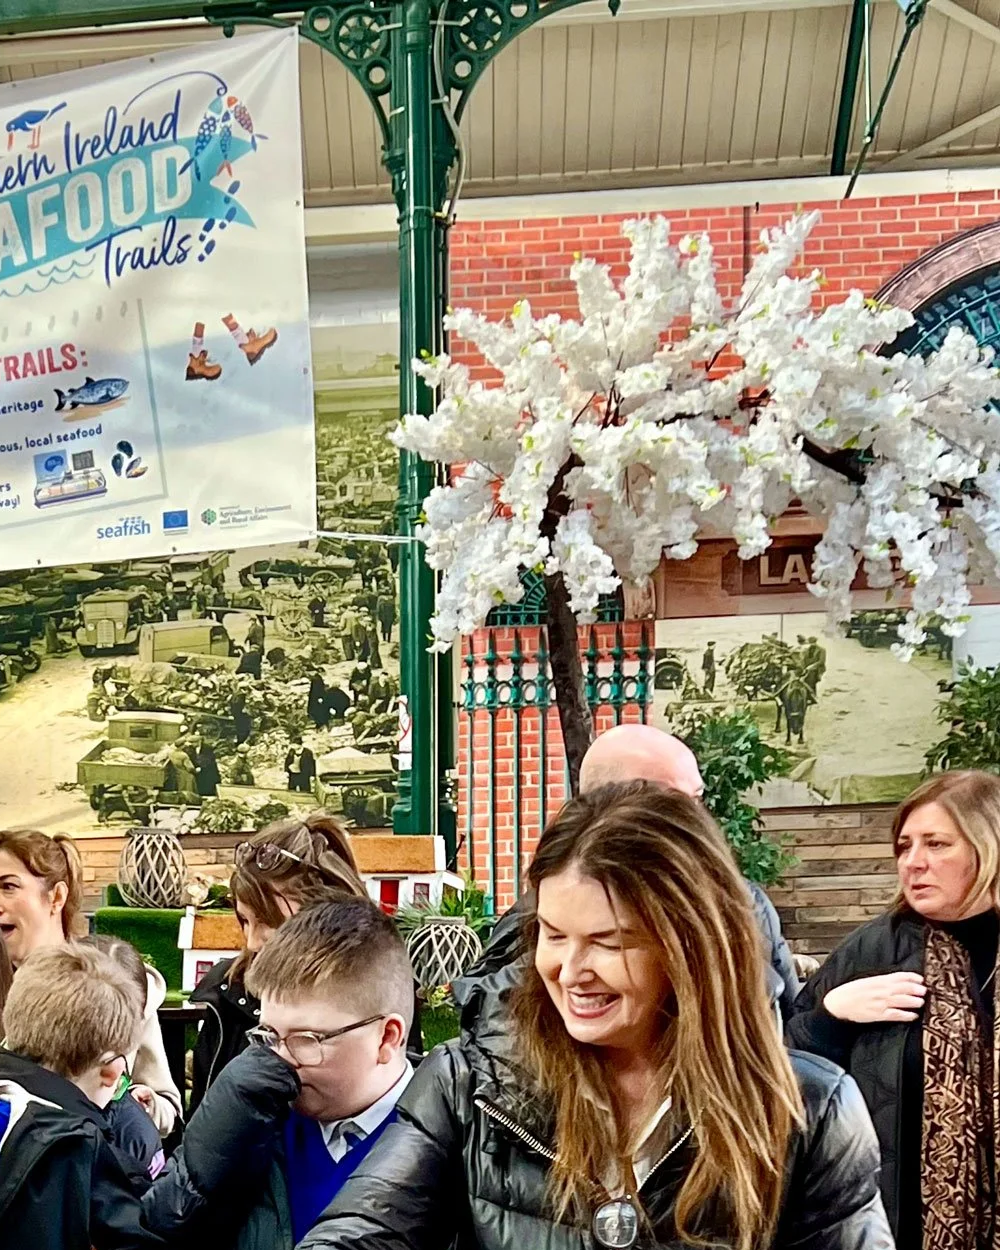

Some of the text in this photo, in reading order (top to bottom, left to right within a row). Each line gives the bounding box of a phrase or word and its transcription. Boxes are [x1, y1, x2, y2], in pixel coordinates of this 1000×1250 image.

[63, 89, 182, 174] Ireland
[85, 215, 191, 288] Trails
[25, 433, 54, 448] local
[56, 424, 103, 444] seafood
[97, 521, 151, 539] seafish
